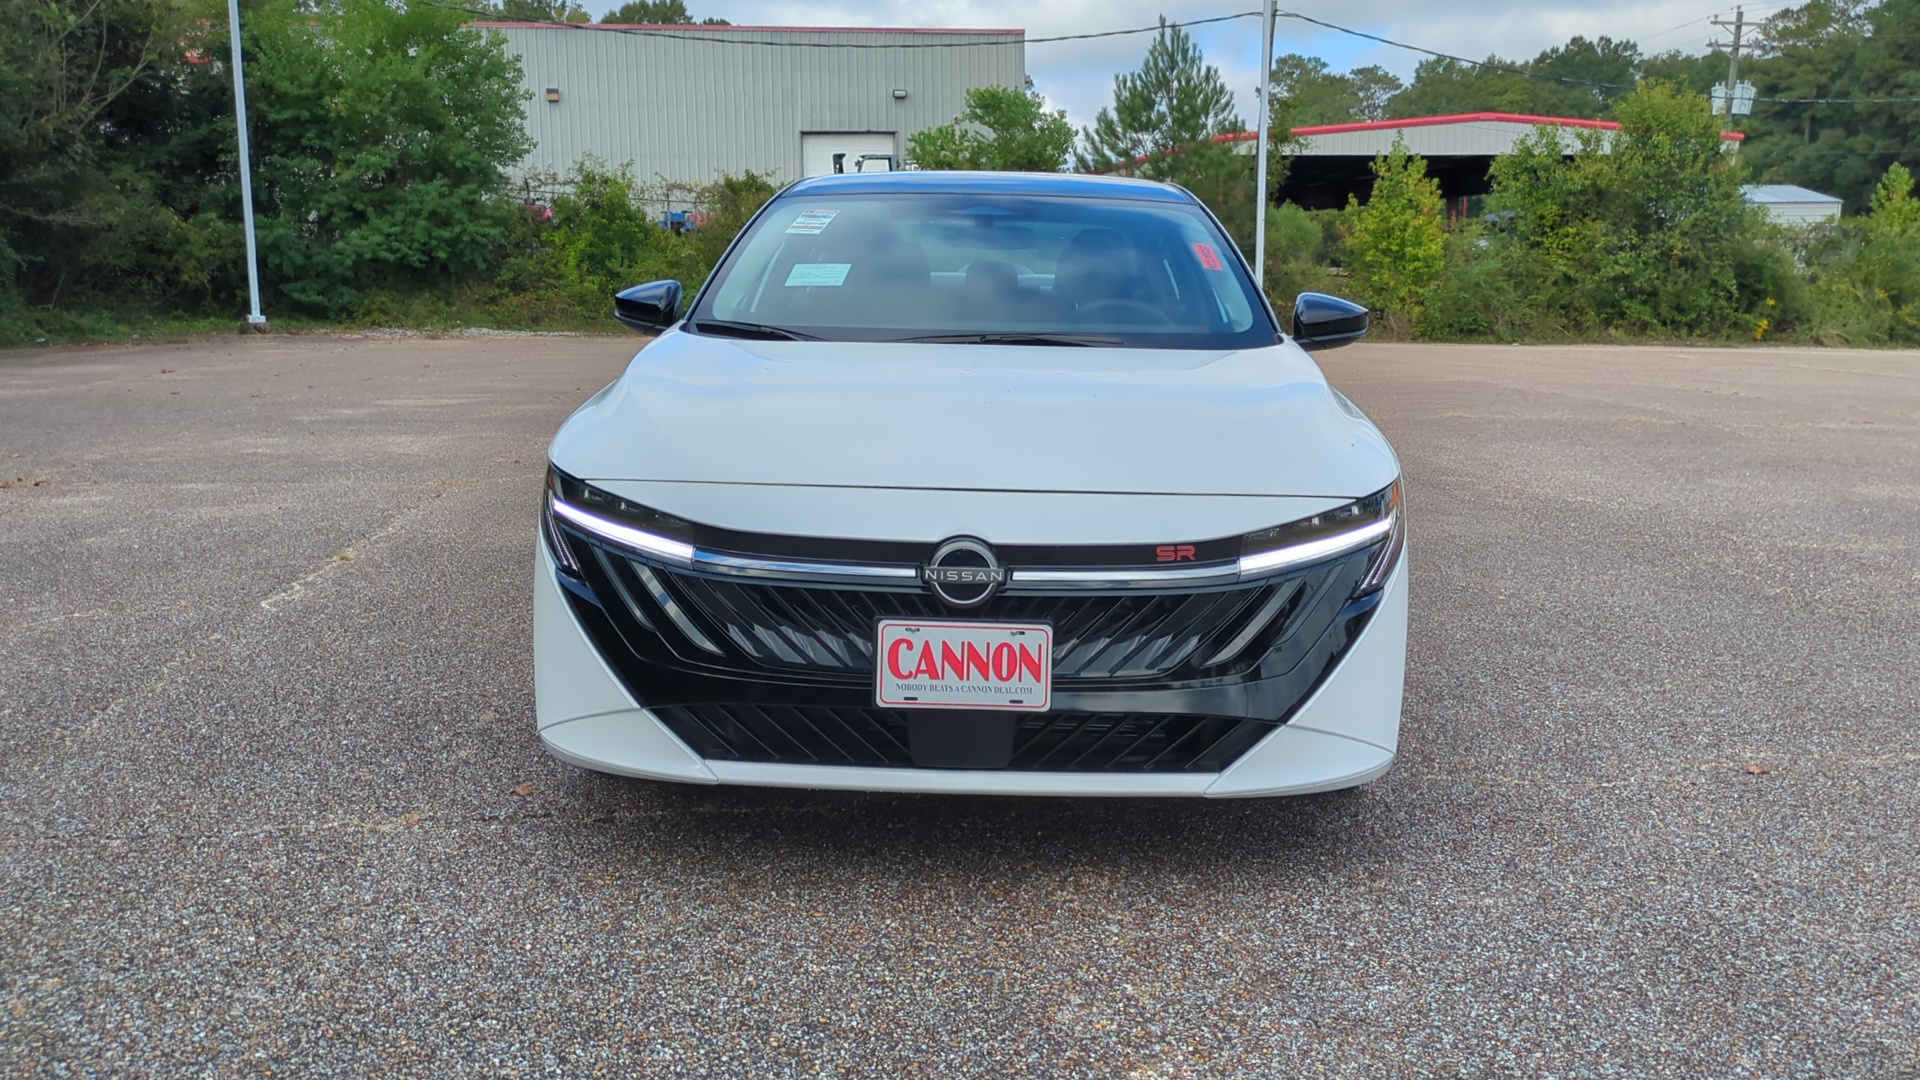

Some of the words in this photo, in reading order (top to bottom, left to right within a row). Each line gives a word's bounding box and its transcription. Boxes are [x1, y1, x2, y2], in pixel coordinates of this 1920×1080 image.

[1156, 545, 1195, 562] SR
[925, 569, 1002, 581] NISSAN
[887, 638, 1042, 683] CANNON
[896, 682, 928, 692] NOBODY
[929, 683, 954, 692] BEATS
[955, 685, 960, 693] A
[961, 684, 993, 694] CANNON
[993, 685, 1033, 695] DEAL.COM
